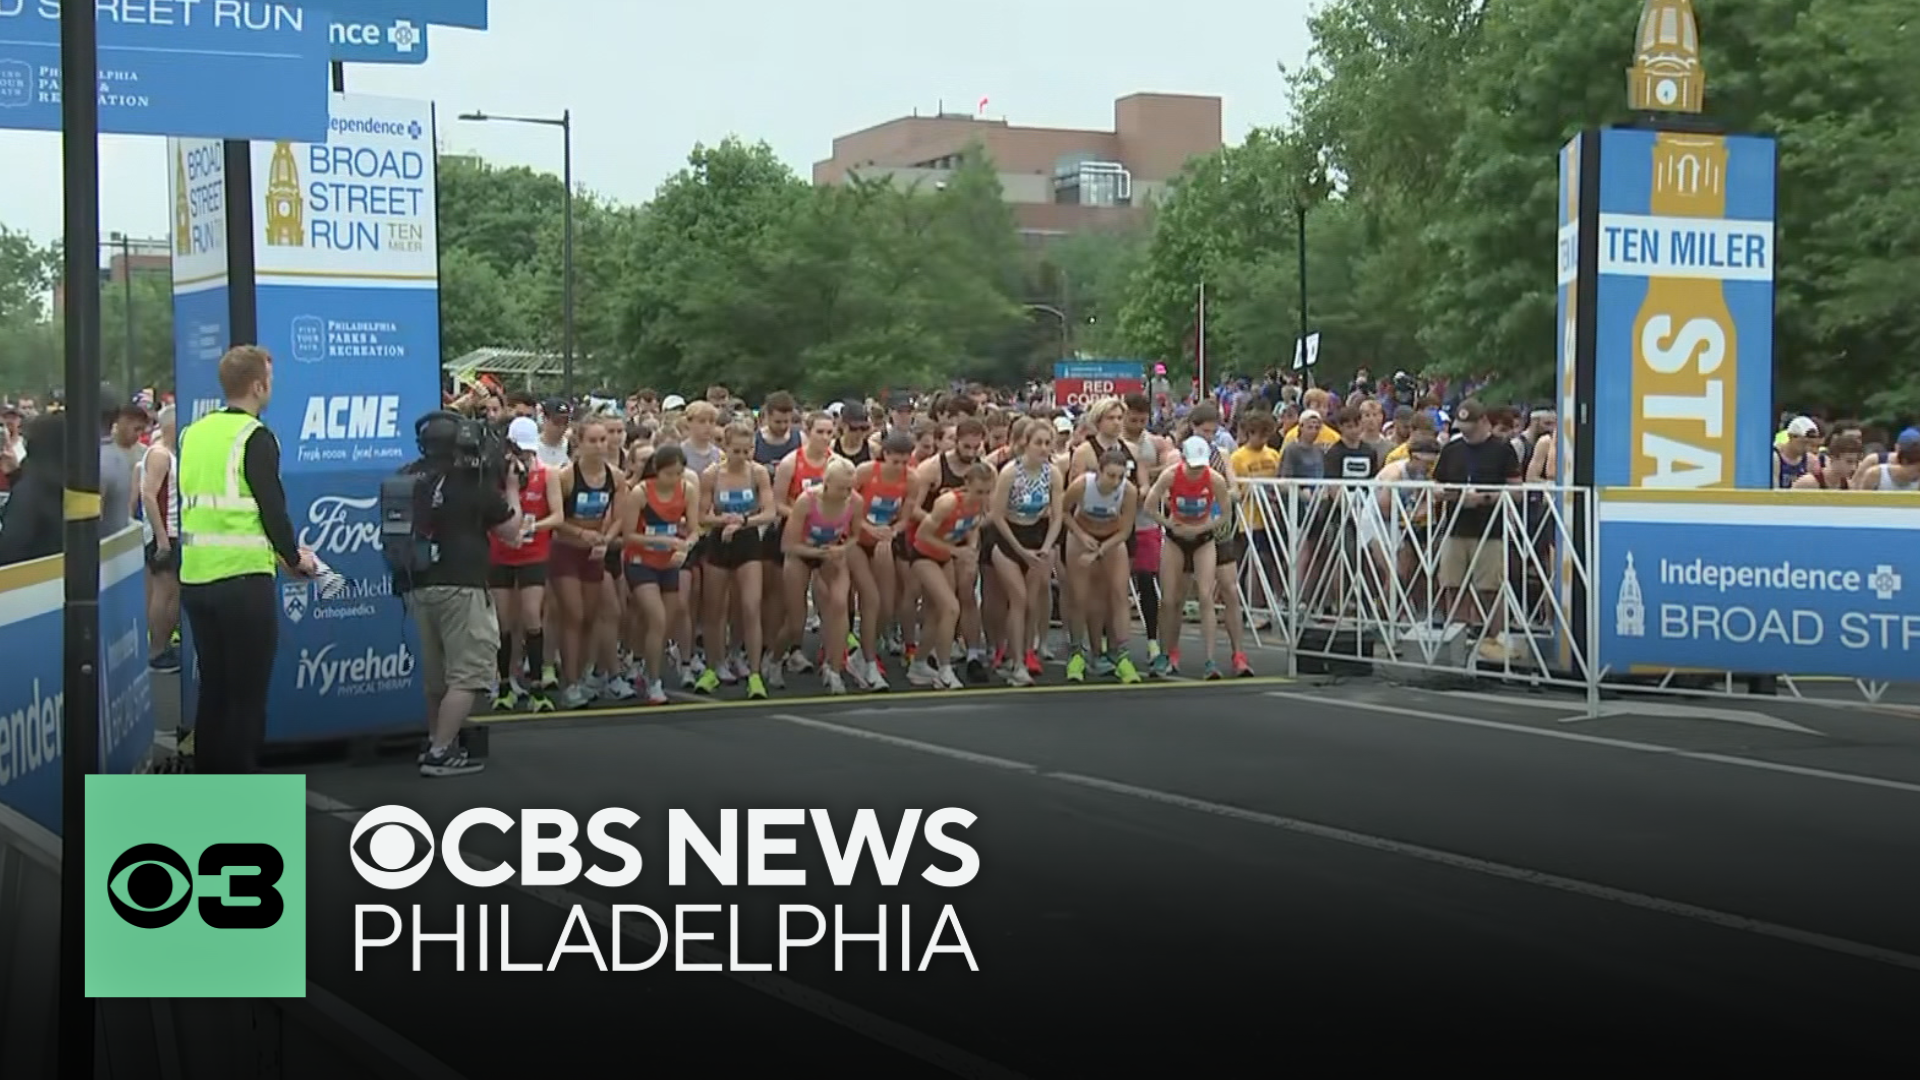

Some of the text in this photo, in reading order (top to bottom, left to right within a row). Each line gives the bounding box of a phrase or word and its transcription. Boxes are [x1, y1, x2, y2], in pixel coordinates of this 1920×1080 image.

[214, 0, 303, 31] RUN
[310, 145, 423, 180] BROAD
[309, 182, 424, 216] STREET
[311, 219, 423, 251] RUN TEN
[1604, 226, 1766, 269] TEN MILER
[328, 333, 367, 344] PARKS
[328, 345, 405, 356] RECREATION
[1083, 380, 1115, 394] RED
[1661, 558, 1861, 593] Independence
[1661, 604, 1824, 645] BROAD
